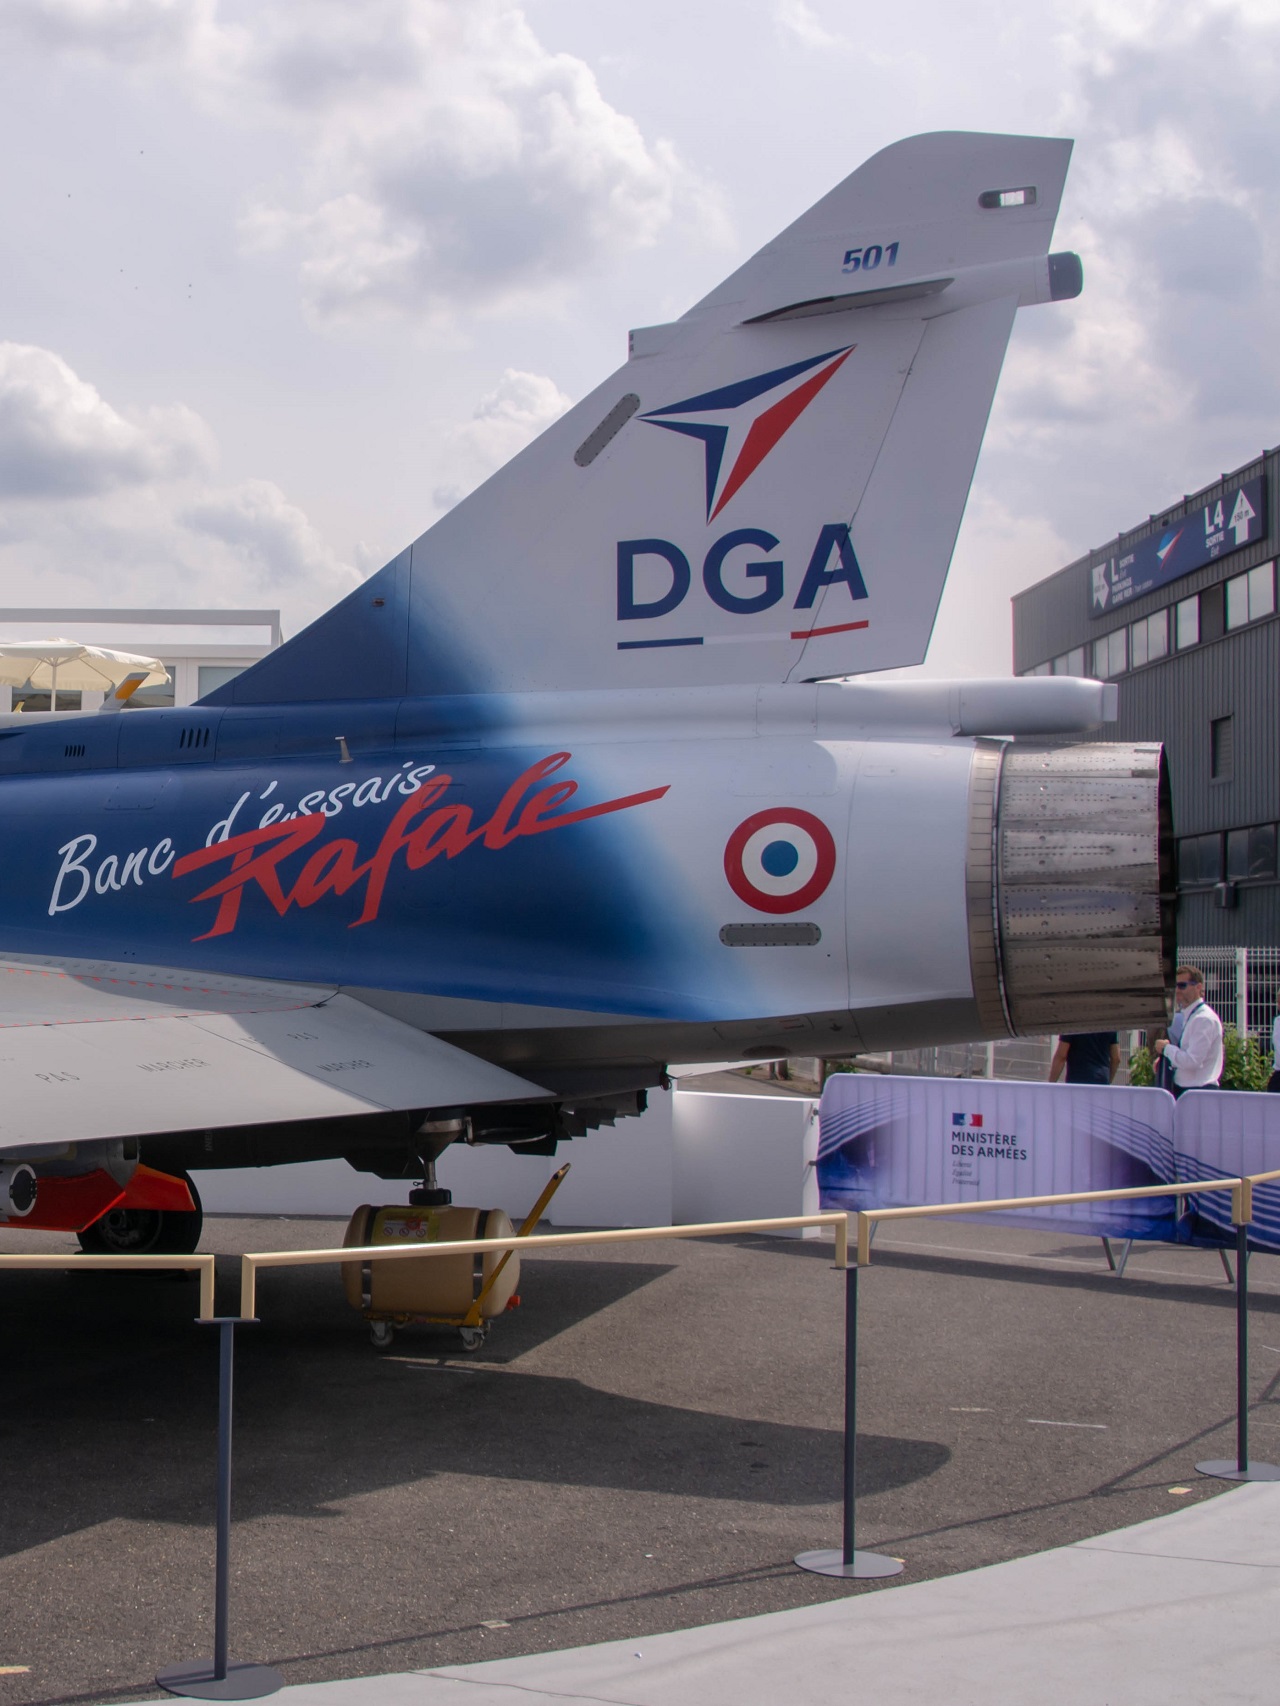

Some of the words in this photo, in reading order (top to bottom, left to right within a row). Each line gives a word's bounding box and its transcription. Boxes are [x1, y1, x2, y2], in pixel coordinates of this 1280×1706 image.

[841, 241, 900, 275] 501
[1205, 500, 1224, 535] L4
[616, 522, 869, 621] DGA
[1111, 558, 1119, 584] L
[48, 833, 176, 916] Banc
[205, 761, 436, 850] d'essais
[171, 751, 672, 942] Rafale
[34, 1071, 81, 1084] PAS
[951, 1131, 1017, 1146] MINISTÈRE
[951, 1144, 974, 1156] DES
[977, 1146, 1027, 1160] ARMÉES
